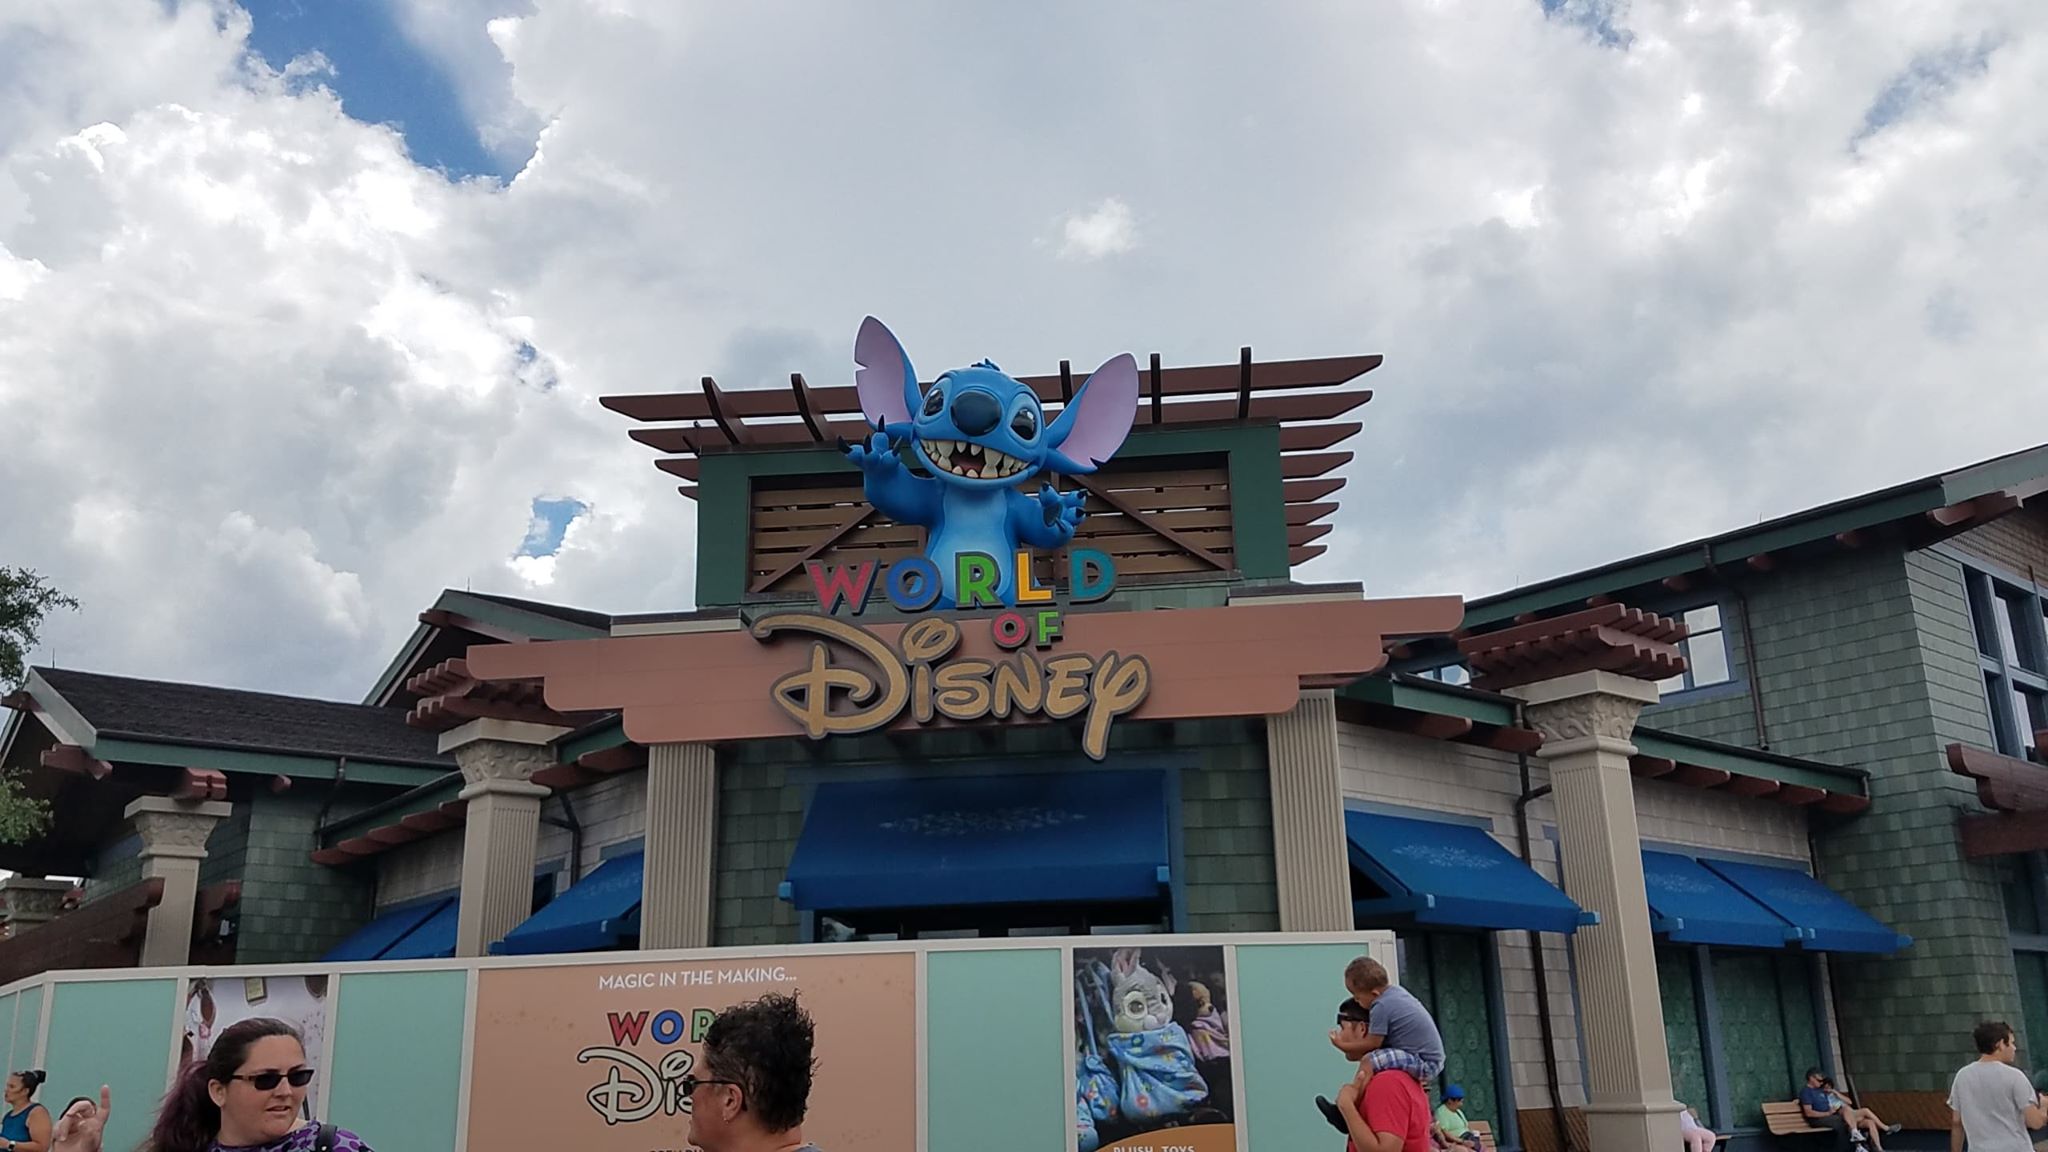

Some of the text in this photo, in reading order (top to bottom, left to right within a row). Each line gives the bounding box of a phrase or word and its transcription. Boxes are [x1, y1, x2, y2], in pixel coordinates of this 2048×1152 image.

[804, 547, 1118, 615] WORLD
[991, 611, 1064, 650] OF
[599, 967, 797, 990] MAGIC IN THE MAKING...
[608, 1008, 717, 1046] WOR
